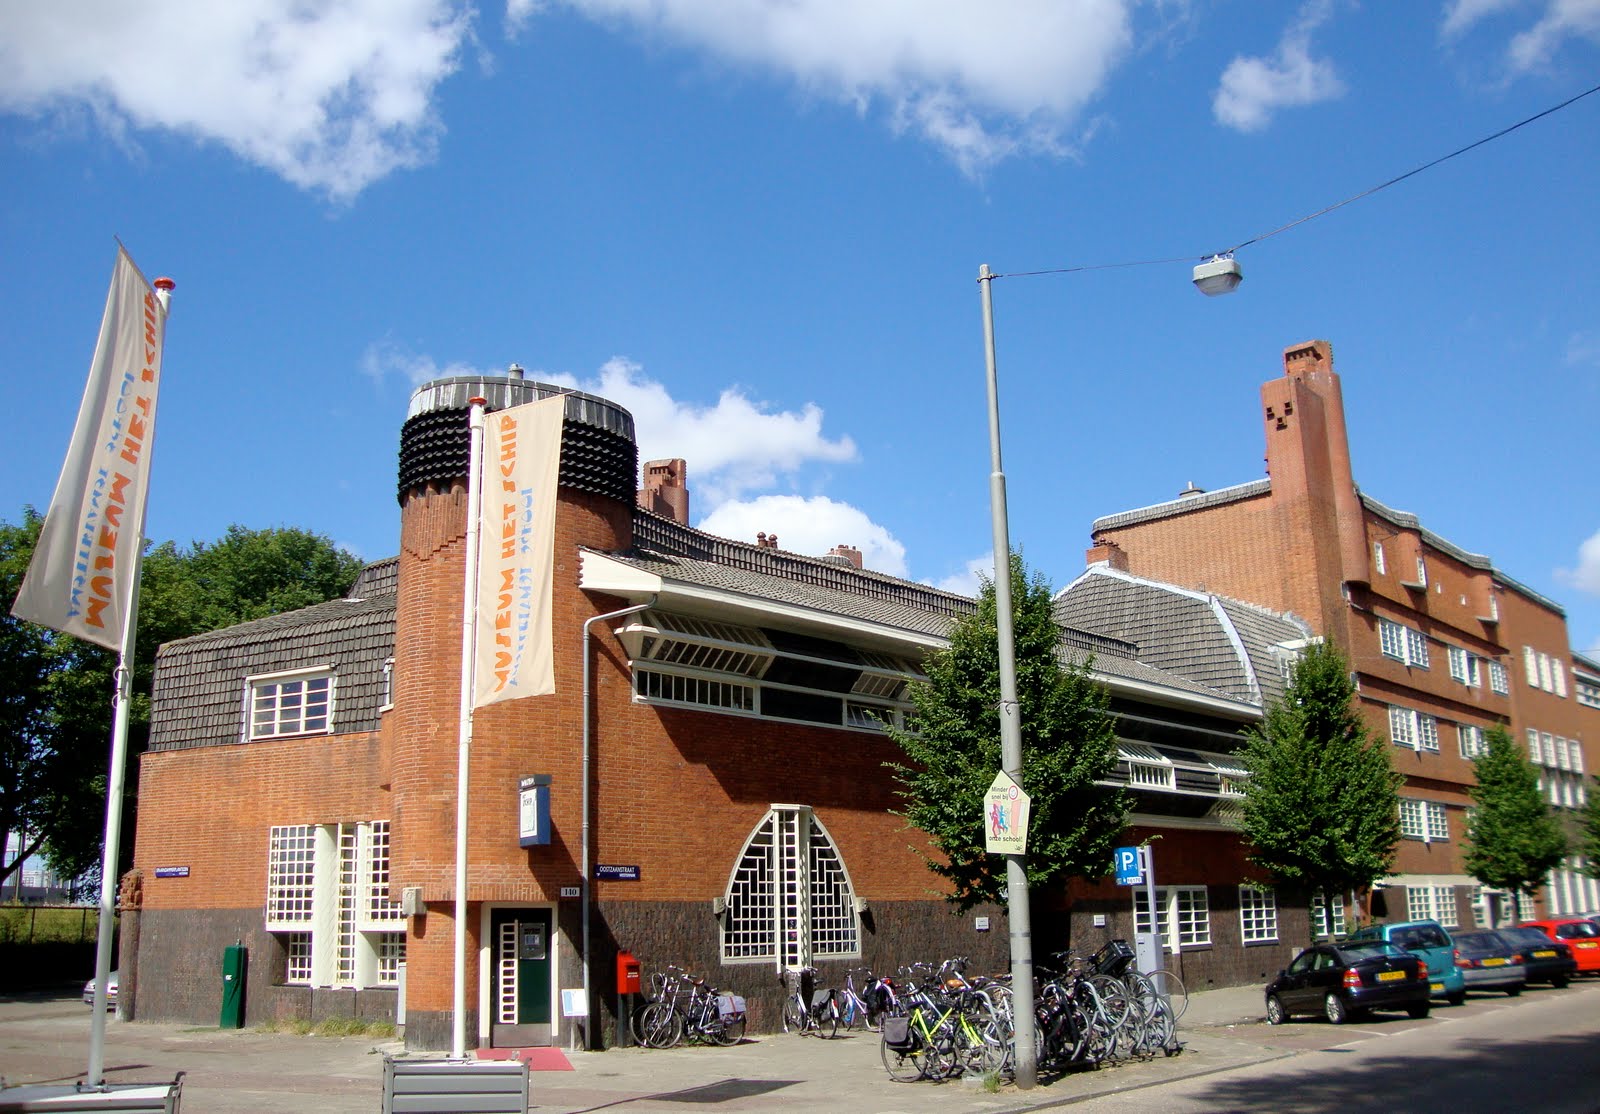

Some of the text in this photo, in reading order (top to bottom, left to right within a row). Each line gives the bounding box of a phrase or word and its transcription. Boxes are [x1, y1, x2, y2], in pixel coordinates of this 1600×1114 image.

[494, 415, 518, 693] MUSEUM HET SCHIP
[599, 865, 635, 873] OOSTZAANSTRAAT
[1121, 851, 1134, 871] P
